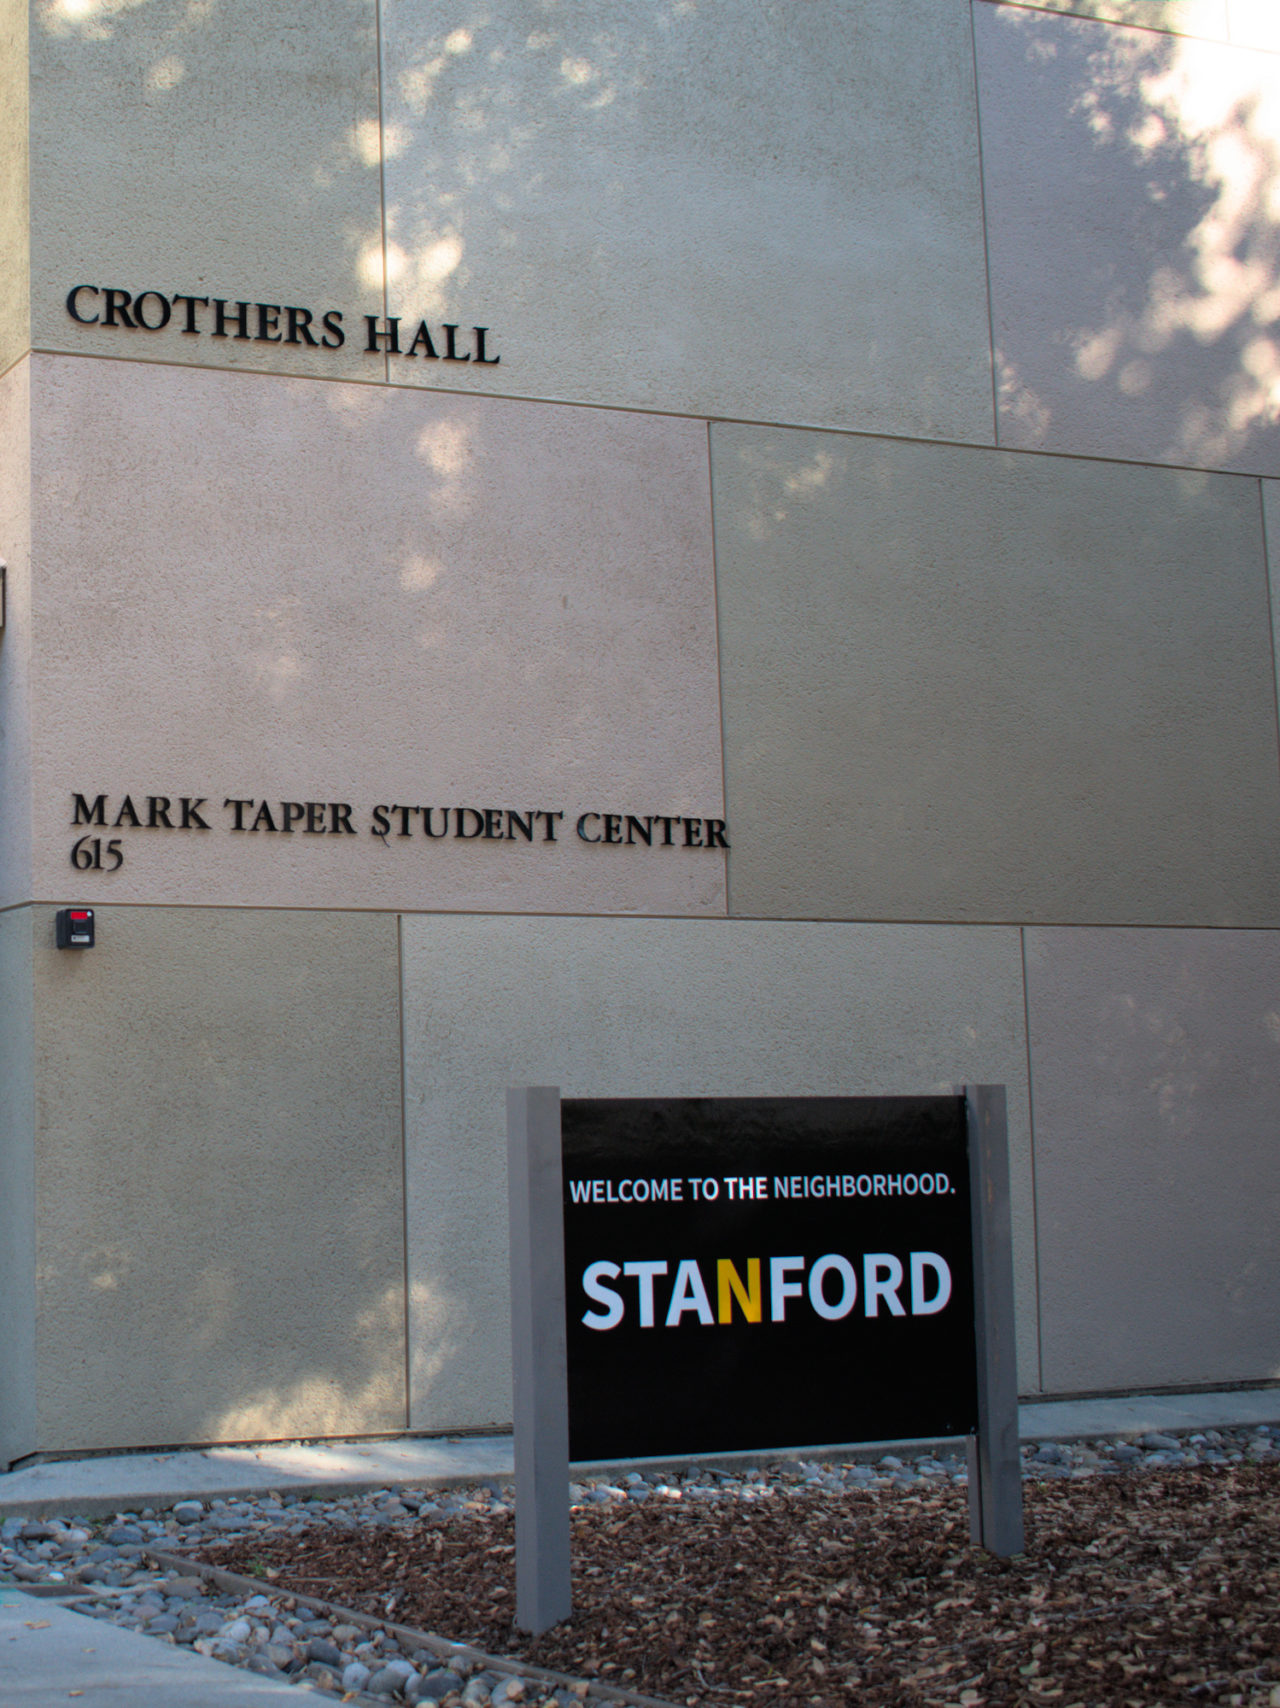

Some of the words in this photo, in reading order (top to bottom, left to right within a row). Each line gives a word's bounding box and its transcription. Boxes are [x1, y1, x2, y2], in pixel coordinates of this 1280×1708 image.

[66, 284, 345, 350] CROTHERS
[363, 315, 501, 365] HALL
[70, 793, 212, 830] MARK
[223, 798, 358, 835] TAPER
[370, 804, 565, 843] STUDENT
[576, 812, 732, 851] CENTER
[70, 835, 124, 872] 615
[569, 1178, 684, 1204] WELCOME
[687, 1177, 719, 1201] TO
[723, 1176, 769, 1200] THE
[774, 1173, 956, 1199] NEIGHBORHOOD.
[580, 1251, 953, 1331] STANFORD
